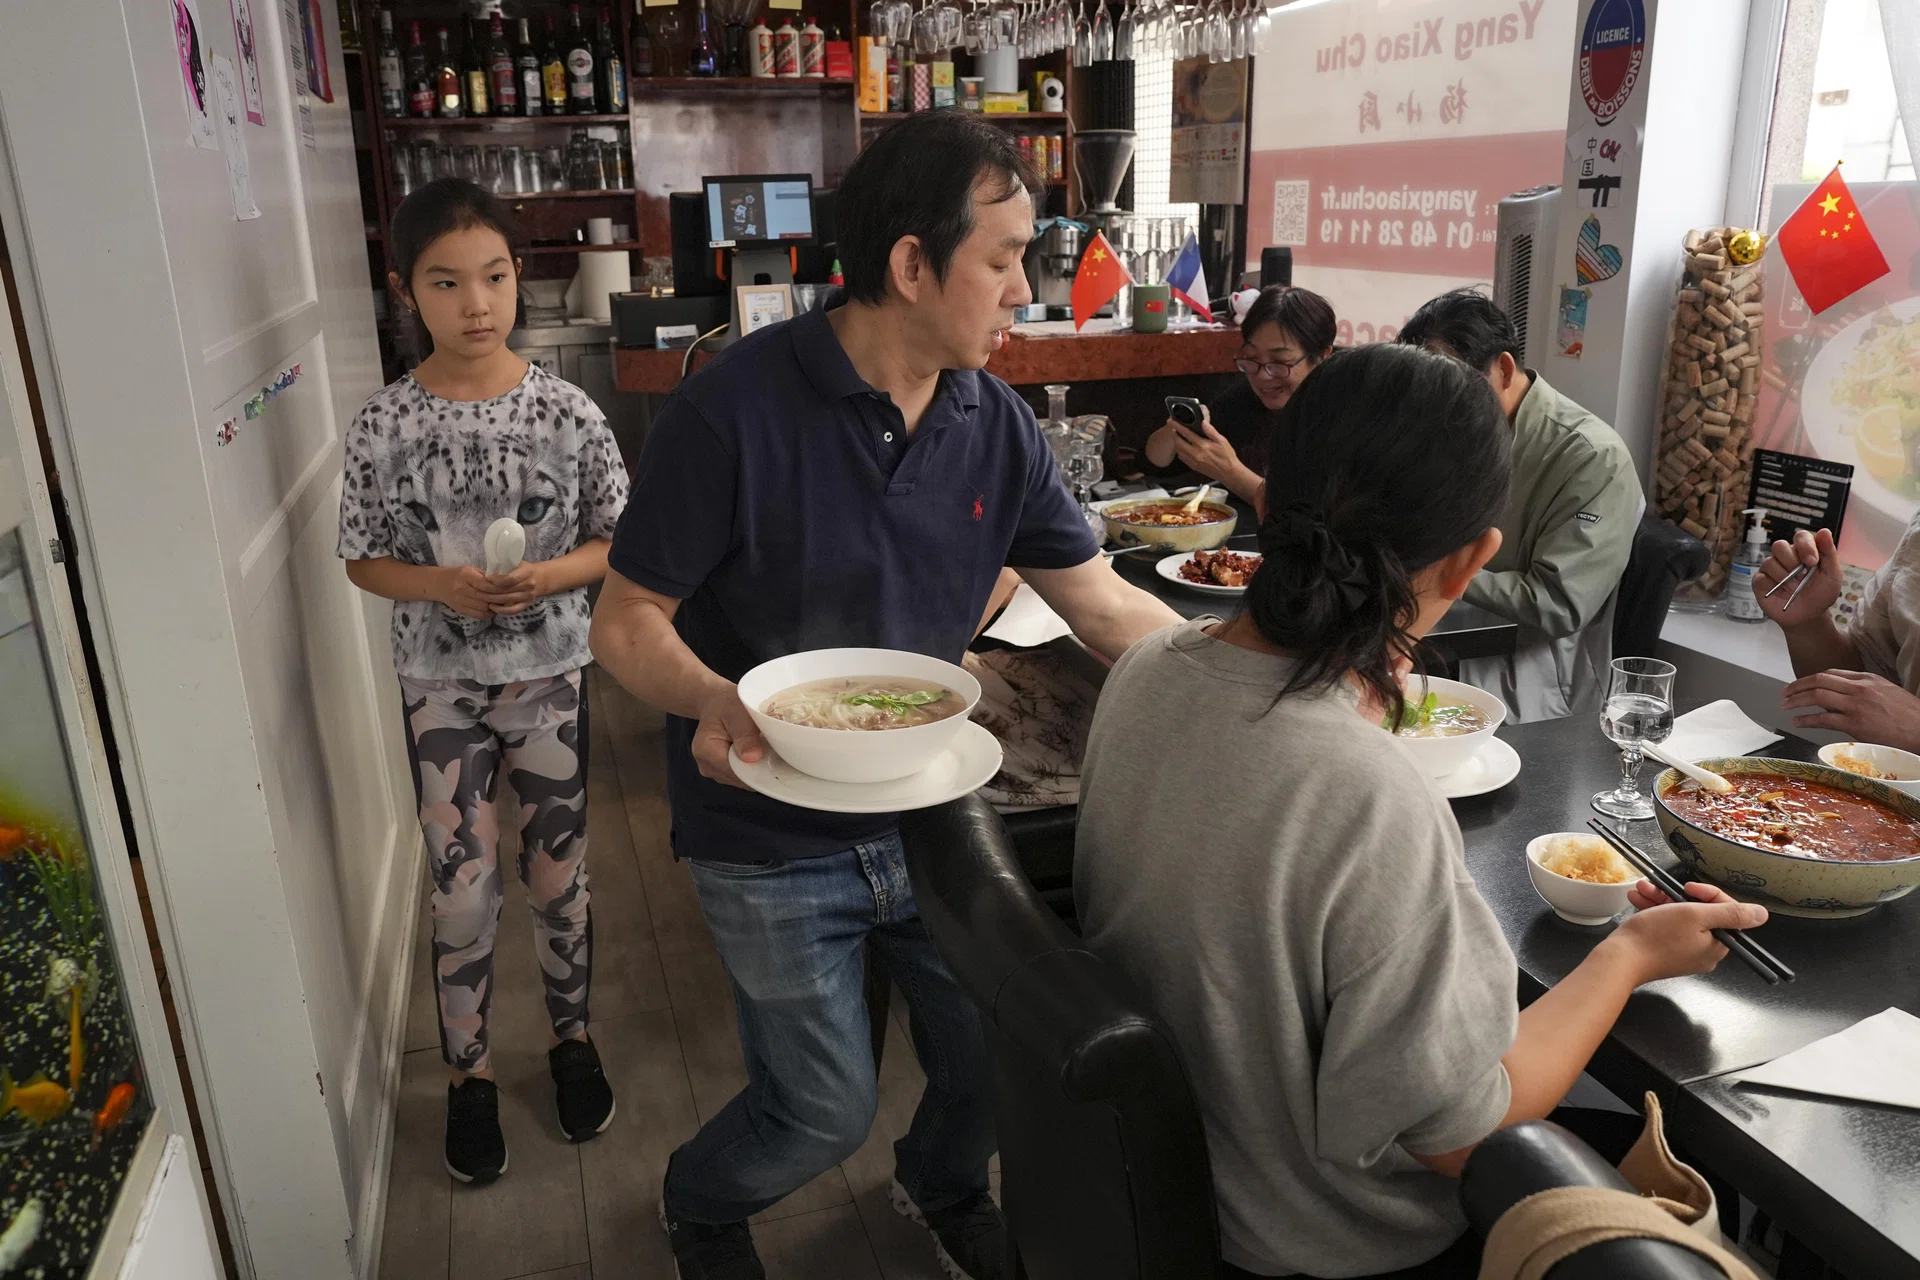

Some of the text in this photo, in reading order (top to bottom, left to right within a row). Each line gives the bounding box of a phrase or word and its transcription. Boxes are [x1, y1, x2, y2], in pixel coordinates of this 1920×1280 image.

[1596, 27, 1630, 44] LICENCE
[1580, 56, 1594, 97] DEBIT
[1597, 49, 1642, 116] BOISSONS
